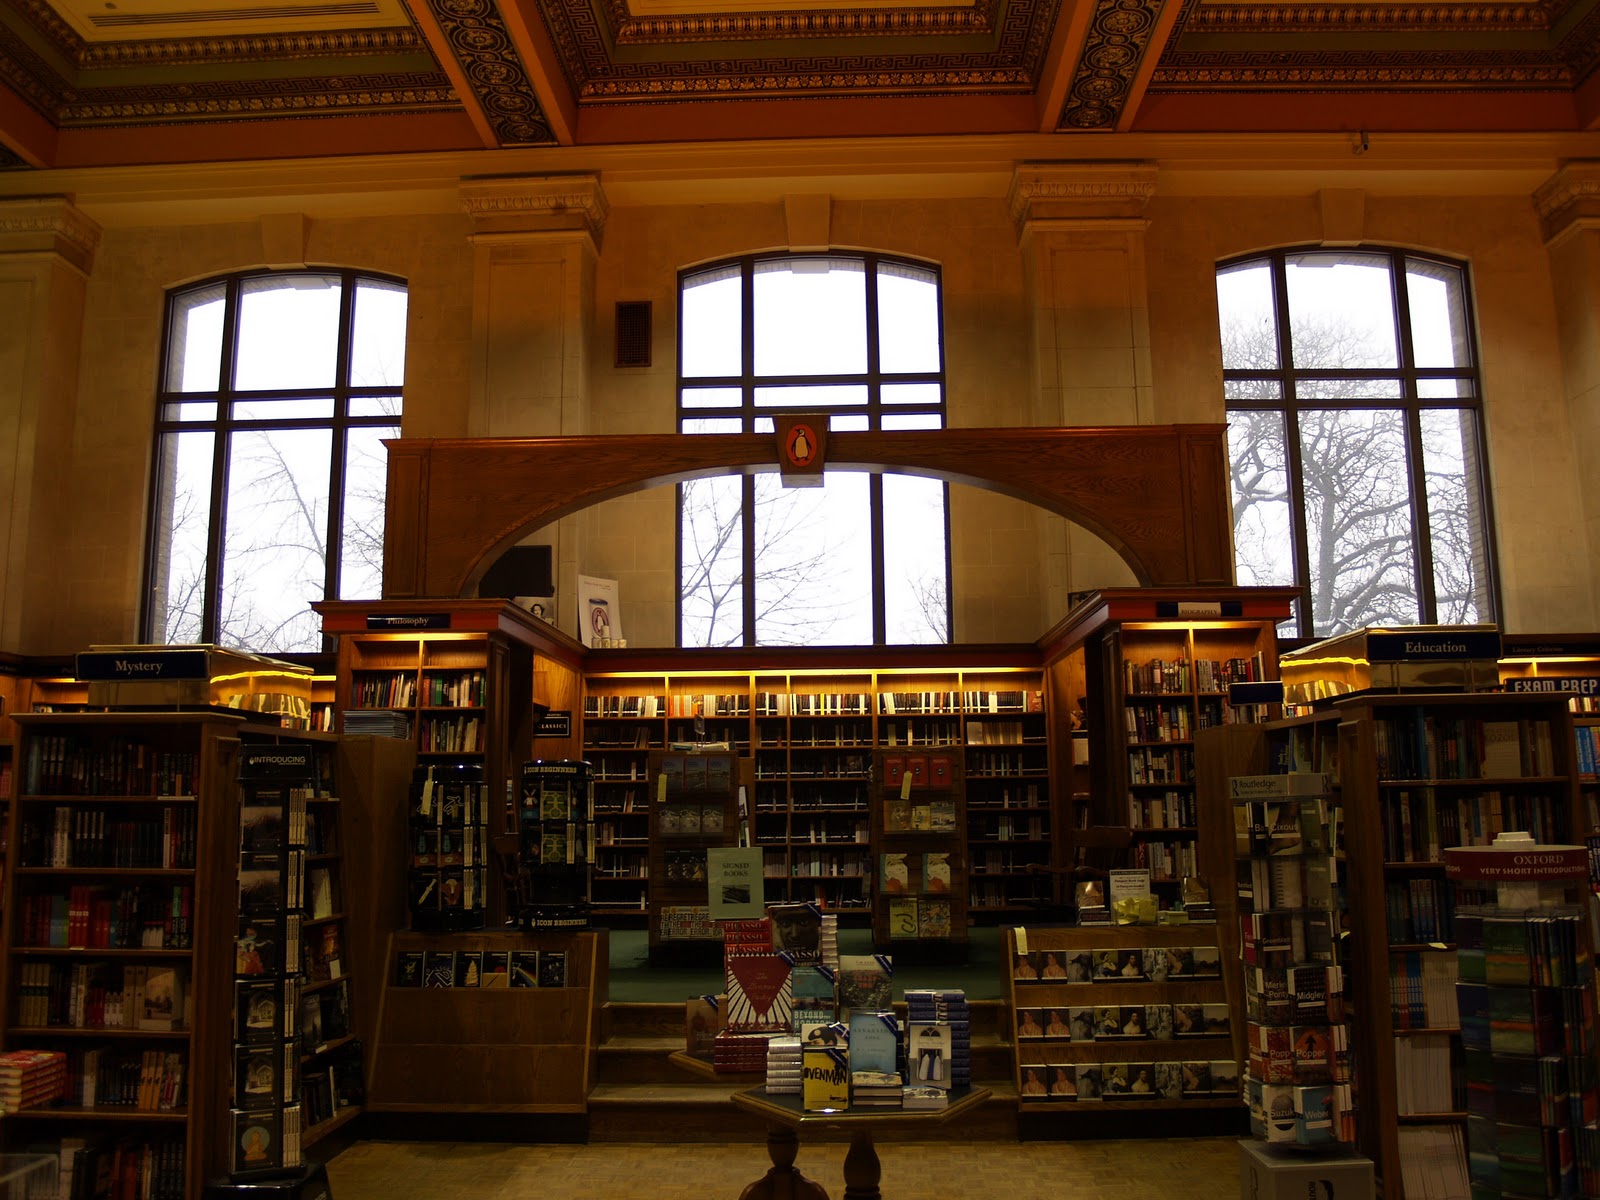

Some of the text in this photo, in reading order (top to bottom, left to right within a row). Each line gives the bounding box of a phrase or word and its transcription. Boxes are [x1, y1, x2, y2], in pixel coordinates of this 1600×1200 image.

[386, 617, 430, 627] Philosophy
[1404, 641, 1468, 653] Education
[115, 660, 164, 675] Mystery
[1514, 679, 1599, 694] EXAM PREP
[253, 756, 306, 764] INTRODUCING
[1239, 779, 1276, 790] Routledge
[1513, 854, 1564, 865] OXFORD
[1480, 865, 1586, 875] VERY SHORT INTRODUCTION
[691, 913, 709, 922] REGRE
[1297, 991, 1326, 1001] Midgley
[794, 1010, 824, 1020] BEYOND
[1296, 1048, 1326, 1060] Popper
[1271, 1108, 1294, 1118] Suzuk
[1305, 1109, 1330, 1120] Weber
